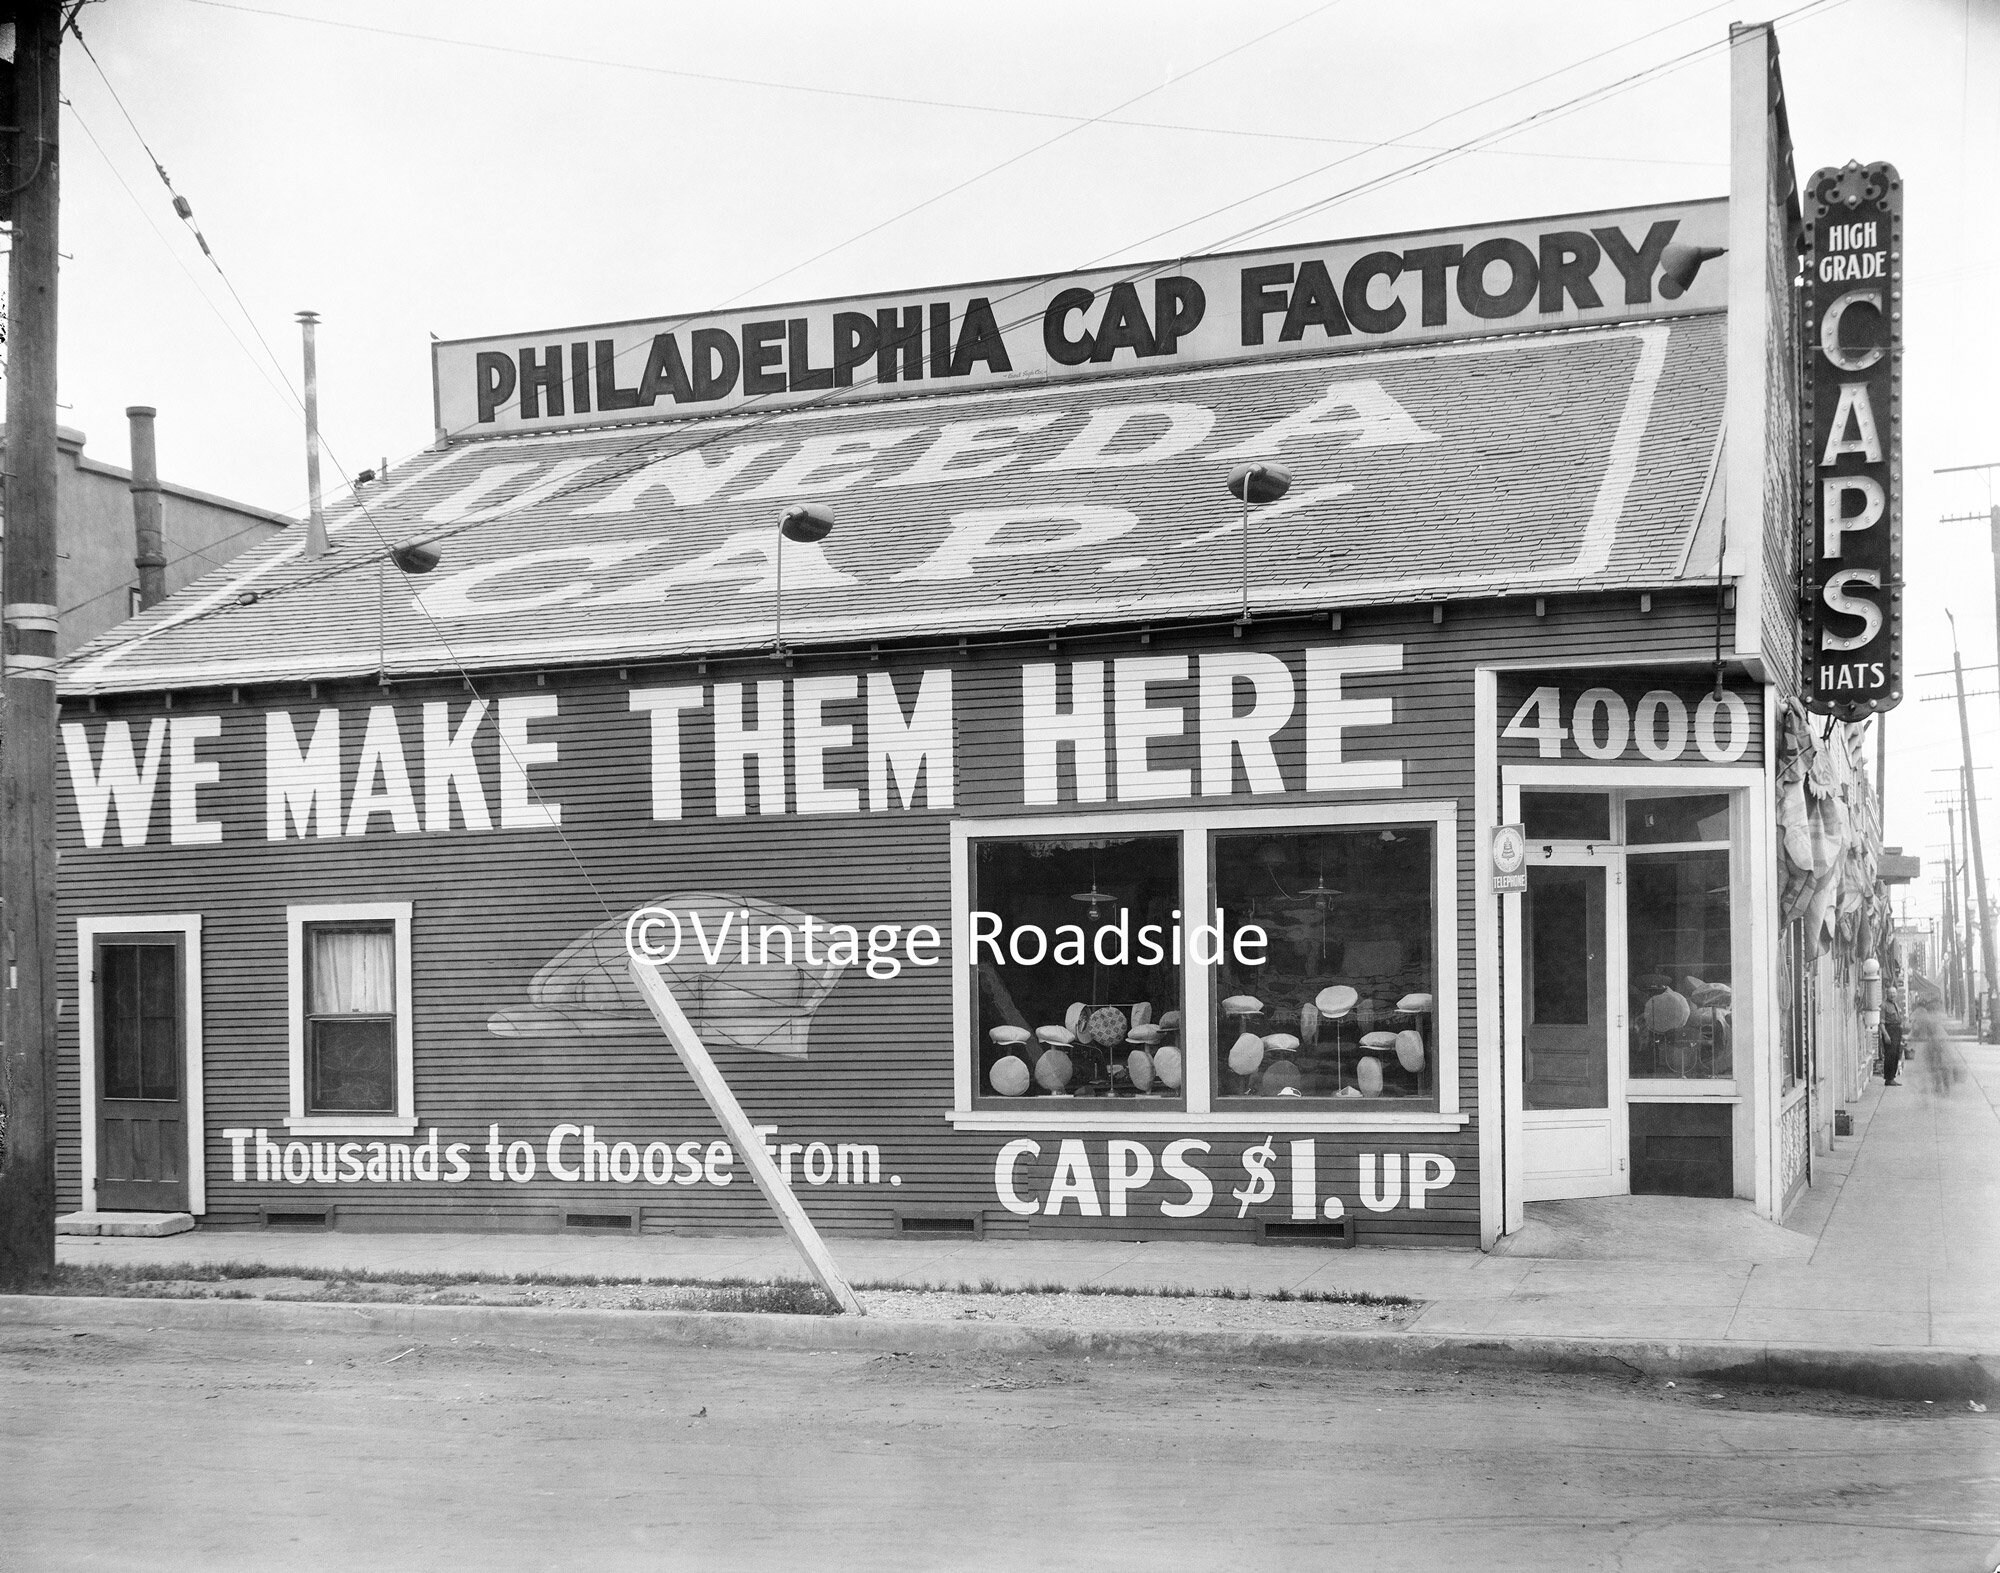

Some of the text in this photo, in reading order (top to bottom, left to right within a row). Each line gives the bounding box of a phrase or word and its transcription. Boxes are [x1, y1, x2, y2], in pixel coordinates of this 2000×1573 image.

[1818, 222, 1888, 283] HIGH GRADE
[476, 219, 1685, 423] PHILADELPHIA CAP FACTORY.
[422, 380, 1443, 523] UNEEDA
[1818, 288, 1886, 653] CAPS
[1819, 663, 1886, 692] HATS
[60, 643, 1405, 849] WE MAKE THEM HERE
[1501, 685, 1750, 763] 4000
[222, 1127, 471, 1184] Thousands
[485, 1123, 536, 1184] to
[546, 1123, 734, 1187] Choose
[994, 1135, 1457, 1220] CAPS $1. UP
